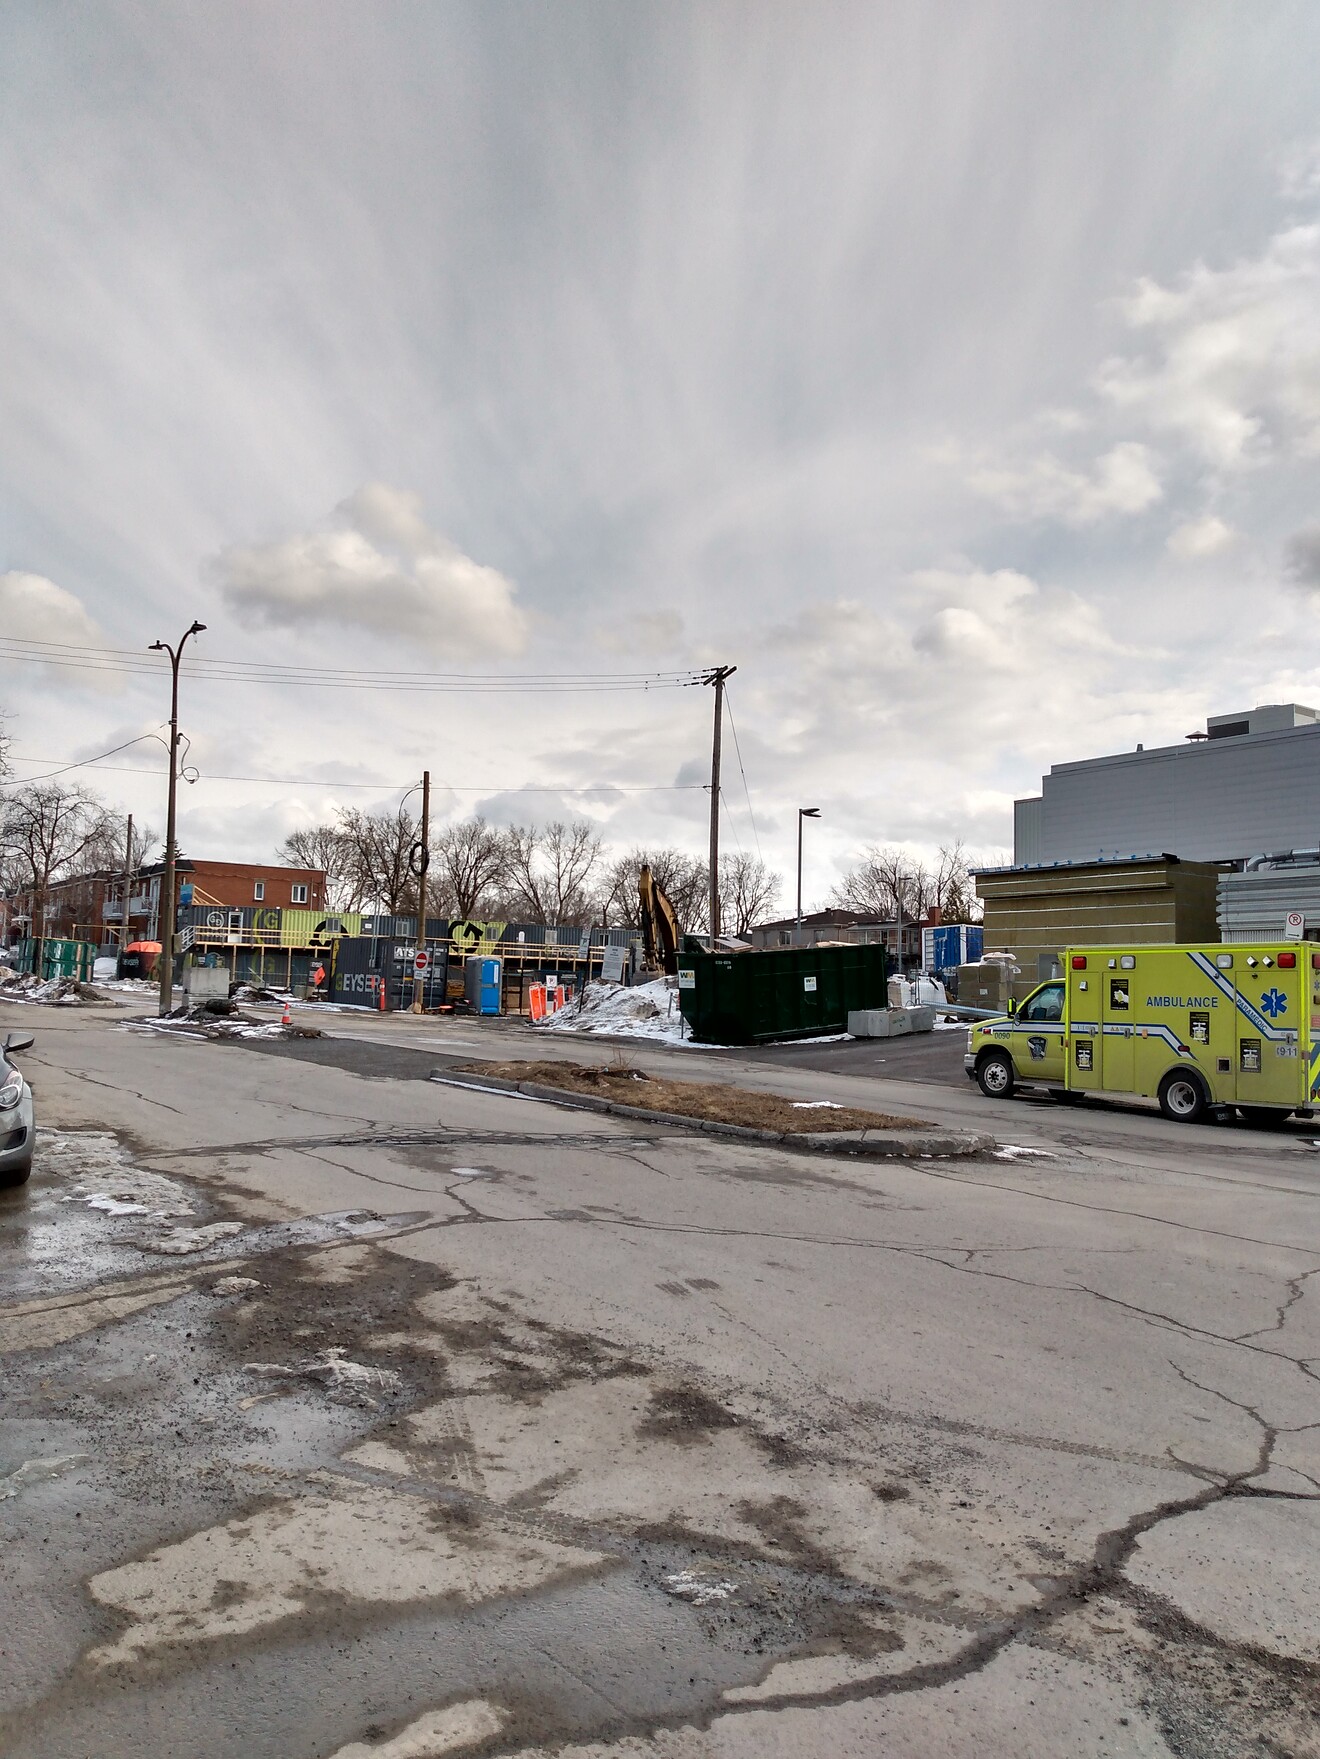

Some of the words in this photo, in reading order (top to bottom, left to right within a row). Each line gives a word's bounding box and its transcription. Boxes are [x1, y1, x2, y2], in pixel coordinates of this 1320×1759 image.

[335, 973, 381, 993] GEYSER
[1146, 996, 1219, 1008] AMBULANCE
[1236, 998, 1268, 1031] PARAMEDIC
